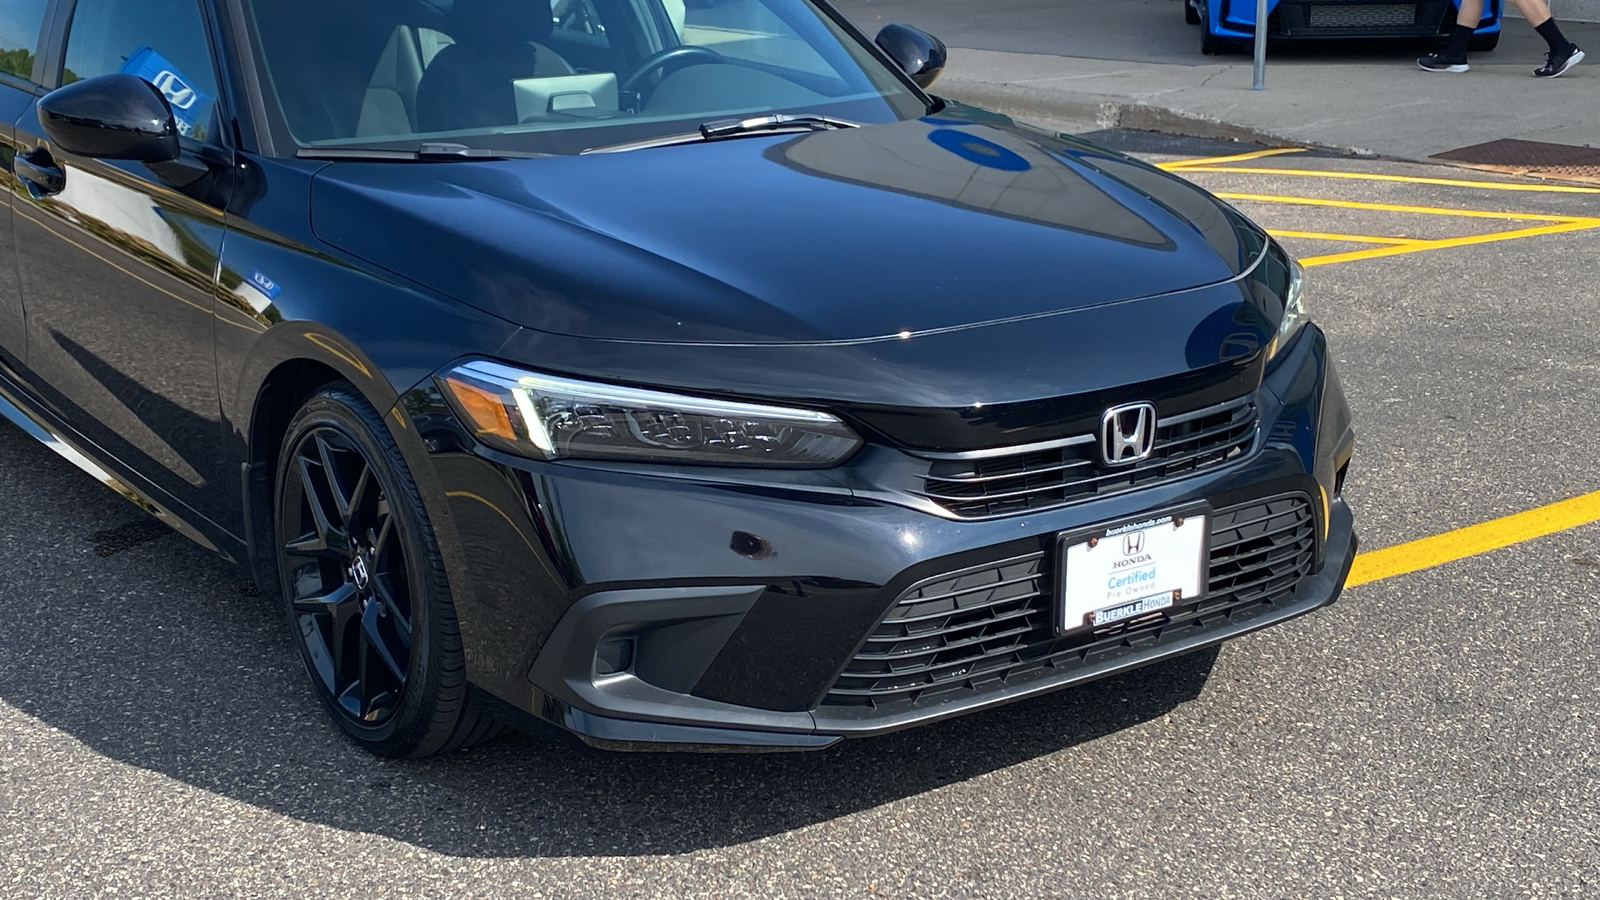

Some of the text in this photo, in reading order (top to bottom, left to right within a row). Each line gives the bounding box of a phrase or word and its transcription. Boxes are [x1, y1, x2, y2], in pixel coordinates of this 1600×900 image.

[1105, 516, 1173, 537] buerklehonda.com
[1112, 554, 1152, 569] HONDA
[1107, 567, 1156, 589] Certified
